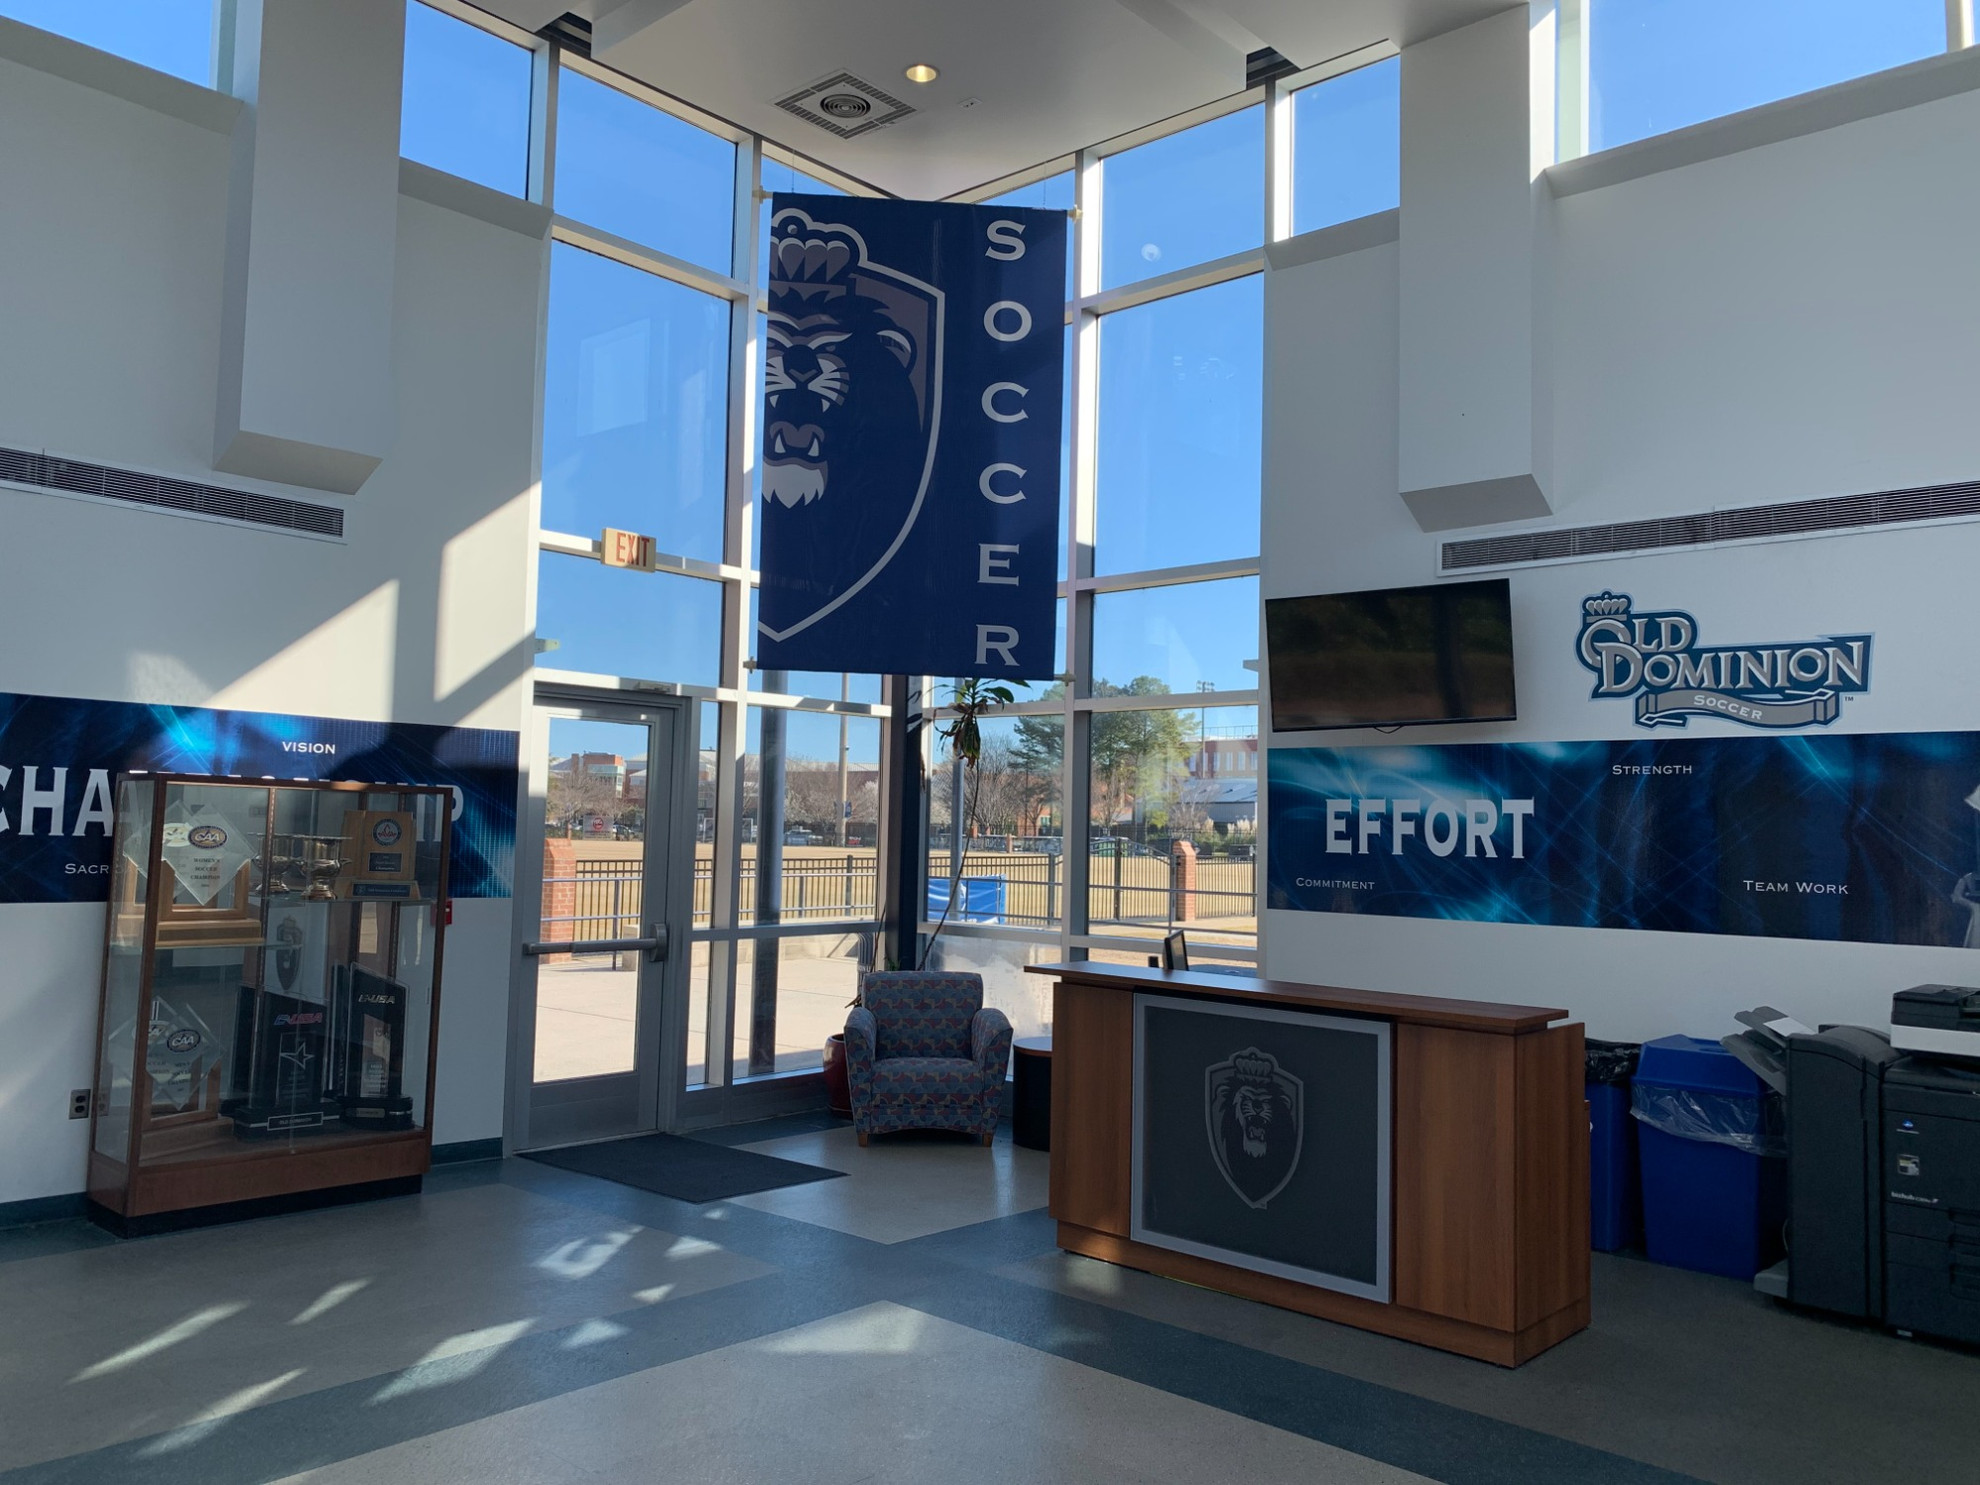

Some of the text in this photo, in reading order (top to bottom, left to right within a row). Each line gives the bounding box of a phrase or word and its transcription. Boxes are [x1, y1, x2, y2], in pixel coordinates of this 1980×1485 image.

[975, 219, 1033, 667] SOCCER
[616, 532, 650, 568] EXIT
[1581, 617, 1693, 666] OLD
[1593, 640, 1864, 693] DOMINION
[1693, 693, 1763, 721] SOCCER
[282, 741, 336, 755] VISION
[1612, 764, 1693, 775] STRENGTH
[1325, 796, 1536, 859] EFFORT
[1295, 877, 1376, 890] COMMITMENT
[1743, 880, 1849, 895] TEAM WORK
